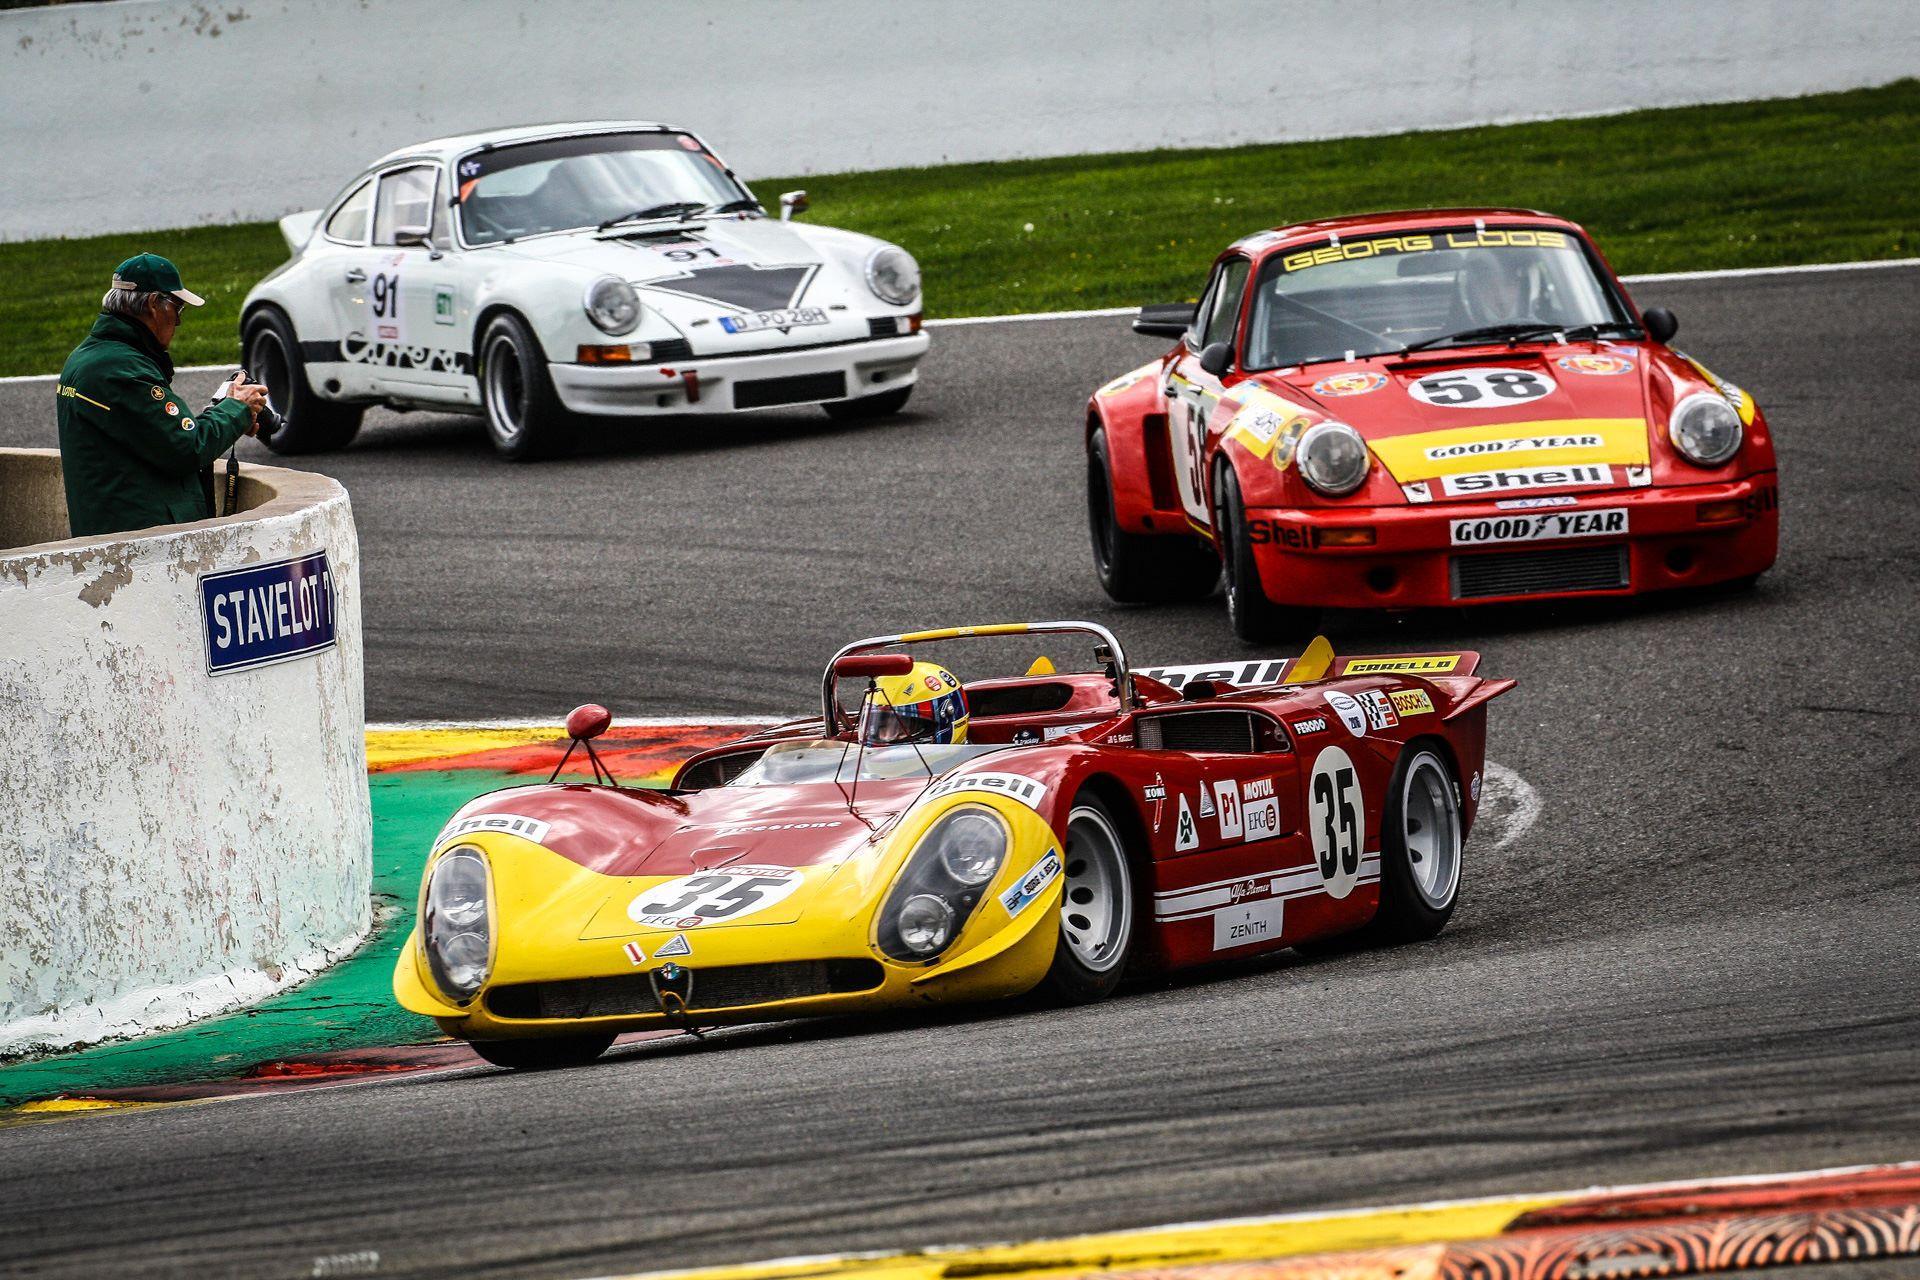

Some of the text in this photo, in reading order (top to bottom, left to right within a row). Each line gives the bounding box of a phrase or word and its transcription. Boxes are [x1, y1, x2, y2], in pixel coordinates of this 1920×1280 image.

[664, 247, 720, 263] 91
[1283, 230, 1567, 272] GEORG LOOS
[373, 273, 399, 318] 91
[341, 331, 465, 373] Carrera
[1419, 371, 1549, 405] 58
[1454, 468, 1602, 491] Shell
[1249, 520, 1321, 549] Shell
[213, 574, 320, 649] STAVELOT
[1134, 662, 1286, 689] hell
[1351, 660, 1453, 672] CARELLO
[1393, 693, 1422, 712] BOSCH
[1293, 718, 1327, 735] FERODO
[1144, 786, 1166, 799] KONI
[1243, 779, 1274, 800] MOTUL
[1220, 791, 1239, 827] P1
[1247, 810, 1266, 831] EFG
[1313, 767, 1359, 880] 35
[641, 875, 793, 919] 35
[1231, 882, 1247, 905] Alfa
[1230, 920, 1268, 939] ZENITH
